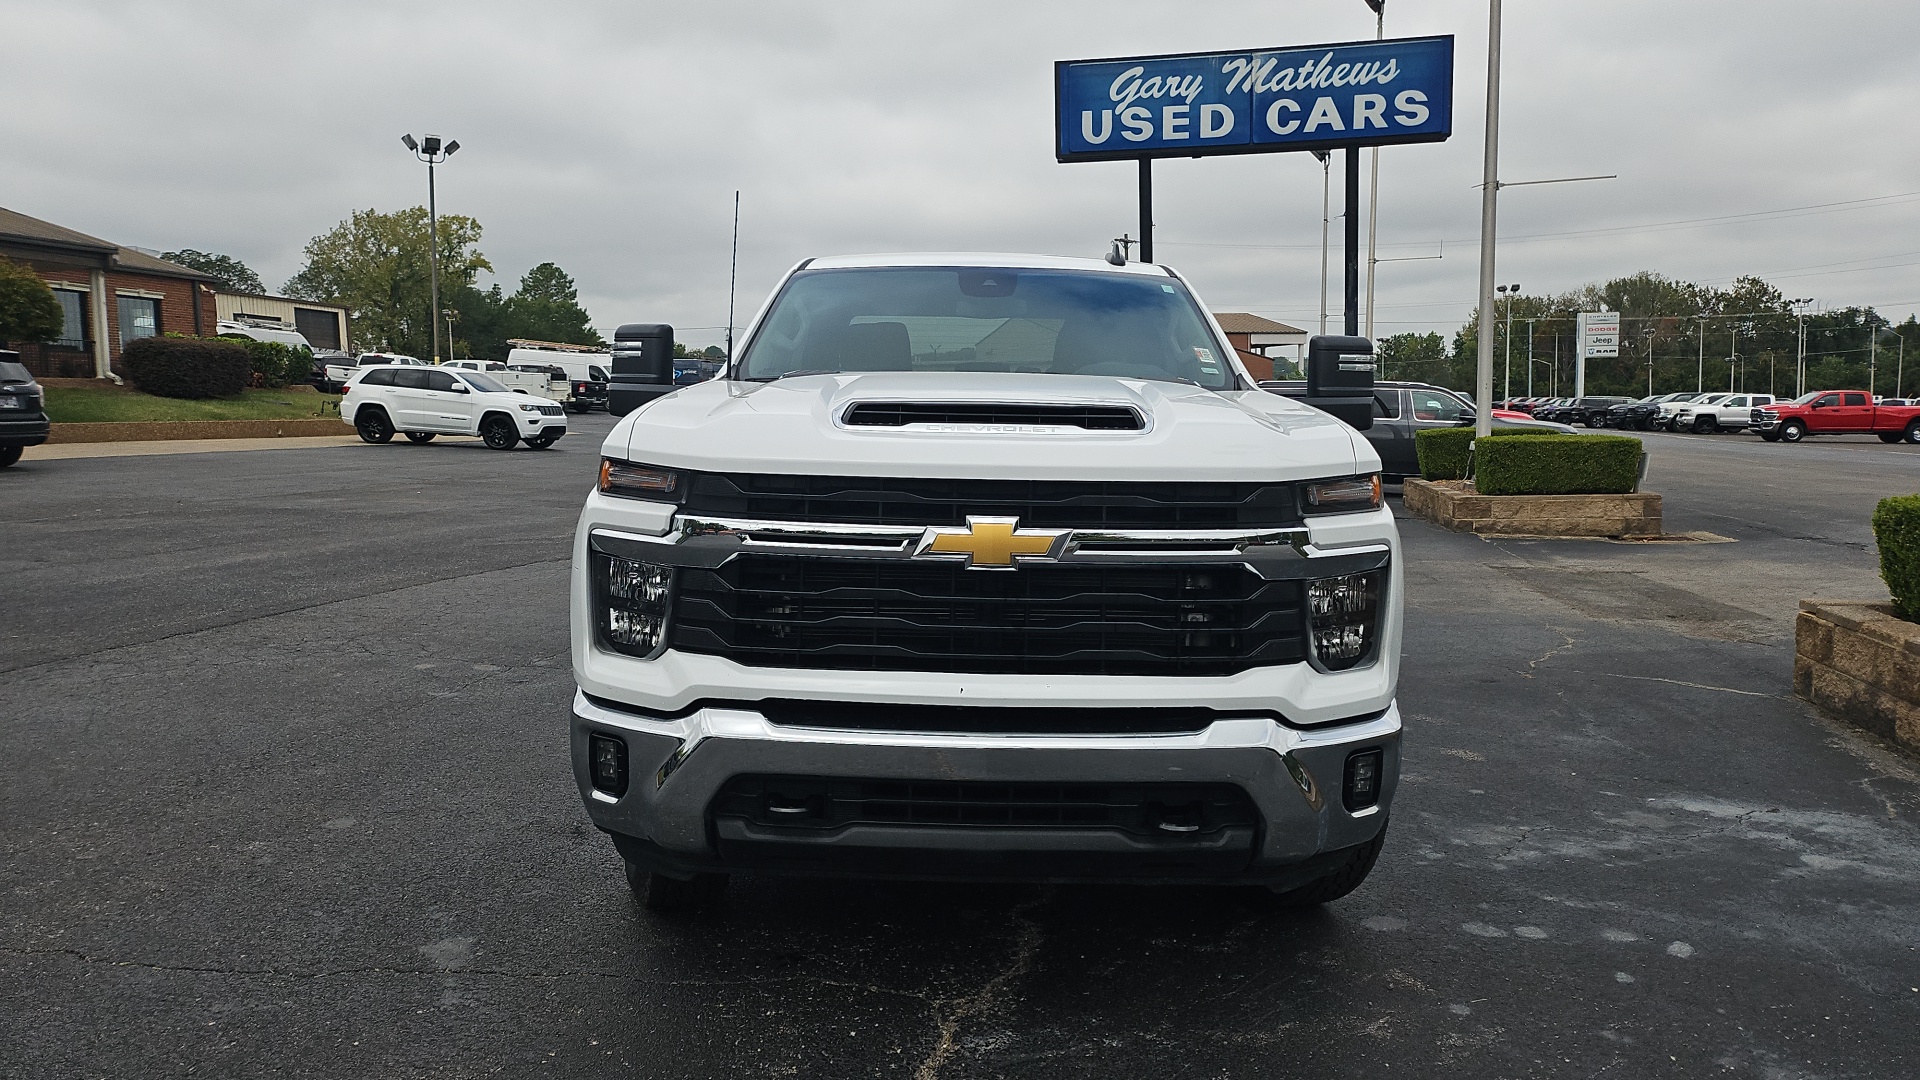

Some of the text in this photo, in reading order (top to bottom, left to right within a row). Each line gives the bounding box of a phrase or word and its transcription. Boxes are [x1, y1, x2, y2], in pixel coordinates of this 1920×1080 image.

[1109, 52, 1400, 115] Gary Mathews
[1081, 90, 1431, 145] USED CARS
[1592, 336, 1613, 345] Jeep
[925, 424, 1061, 433] CHEVROLET
